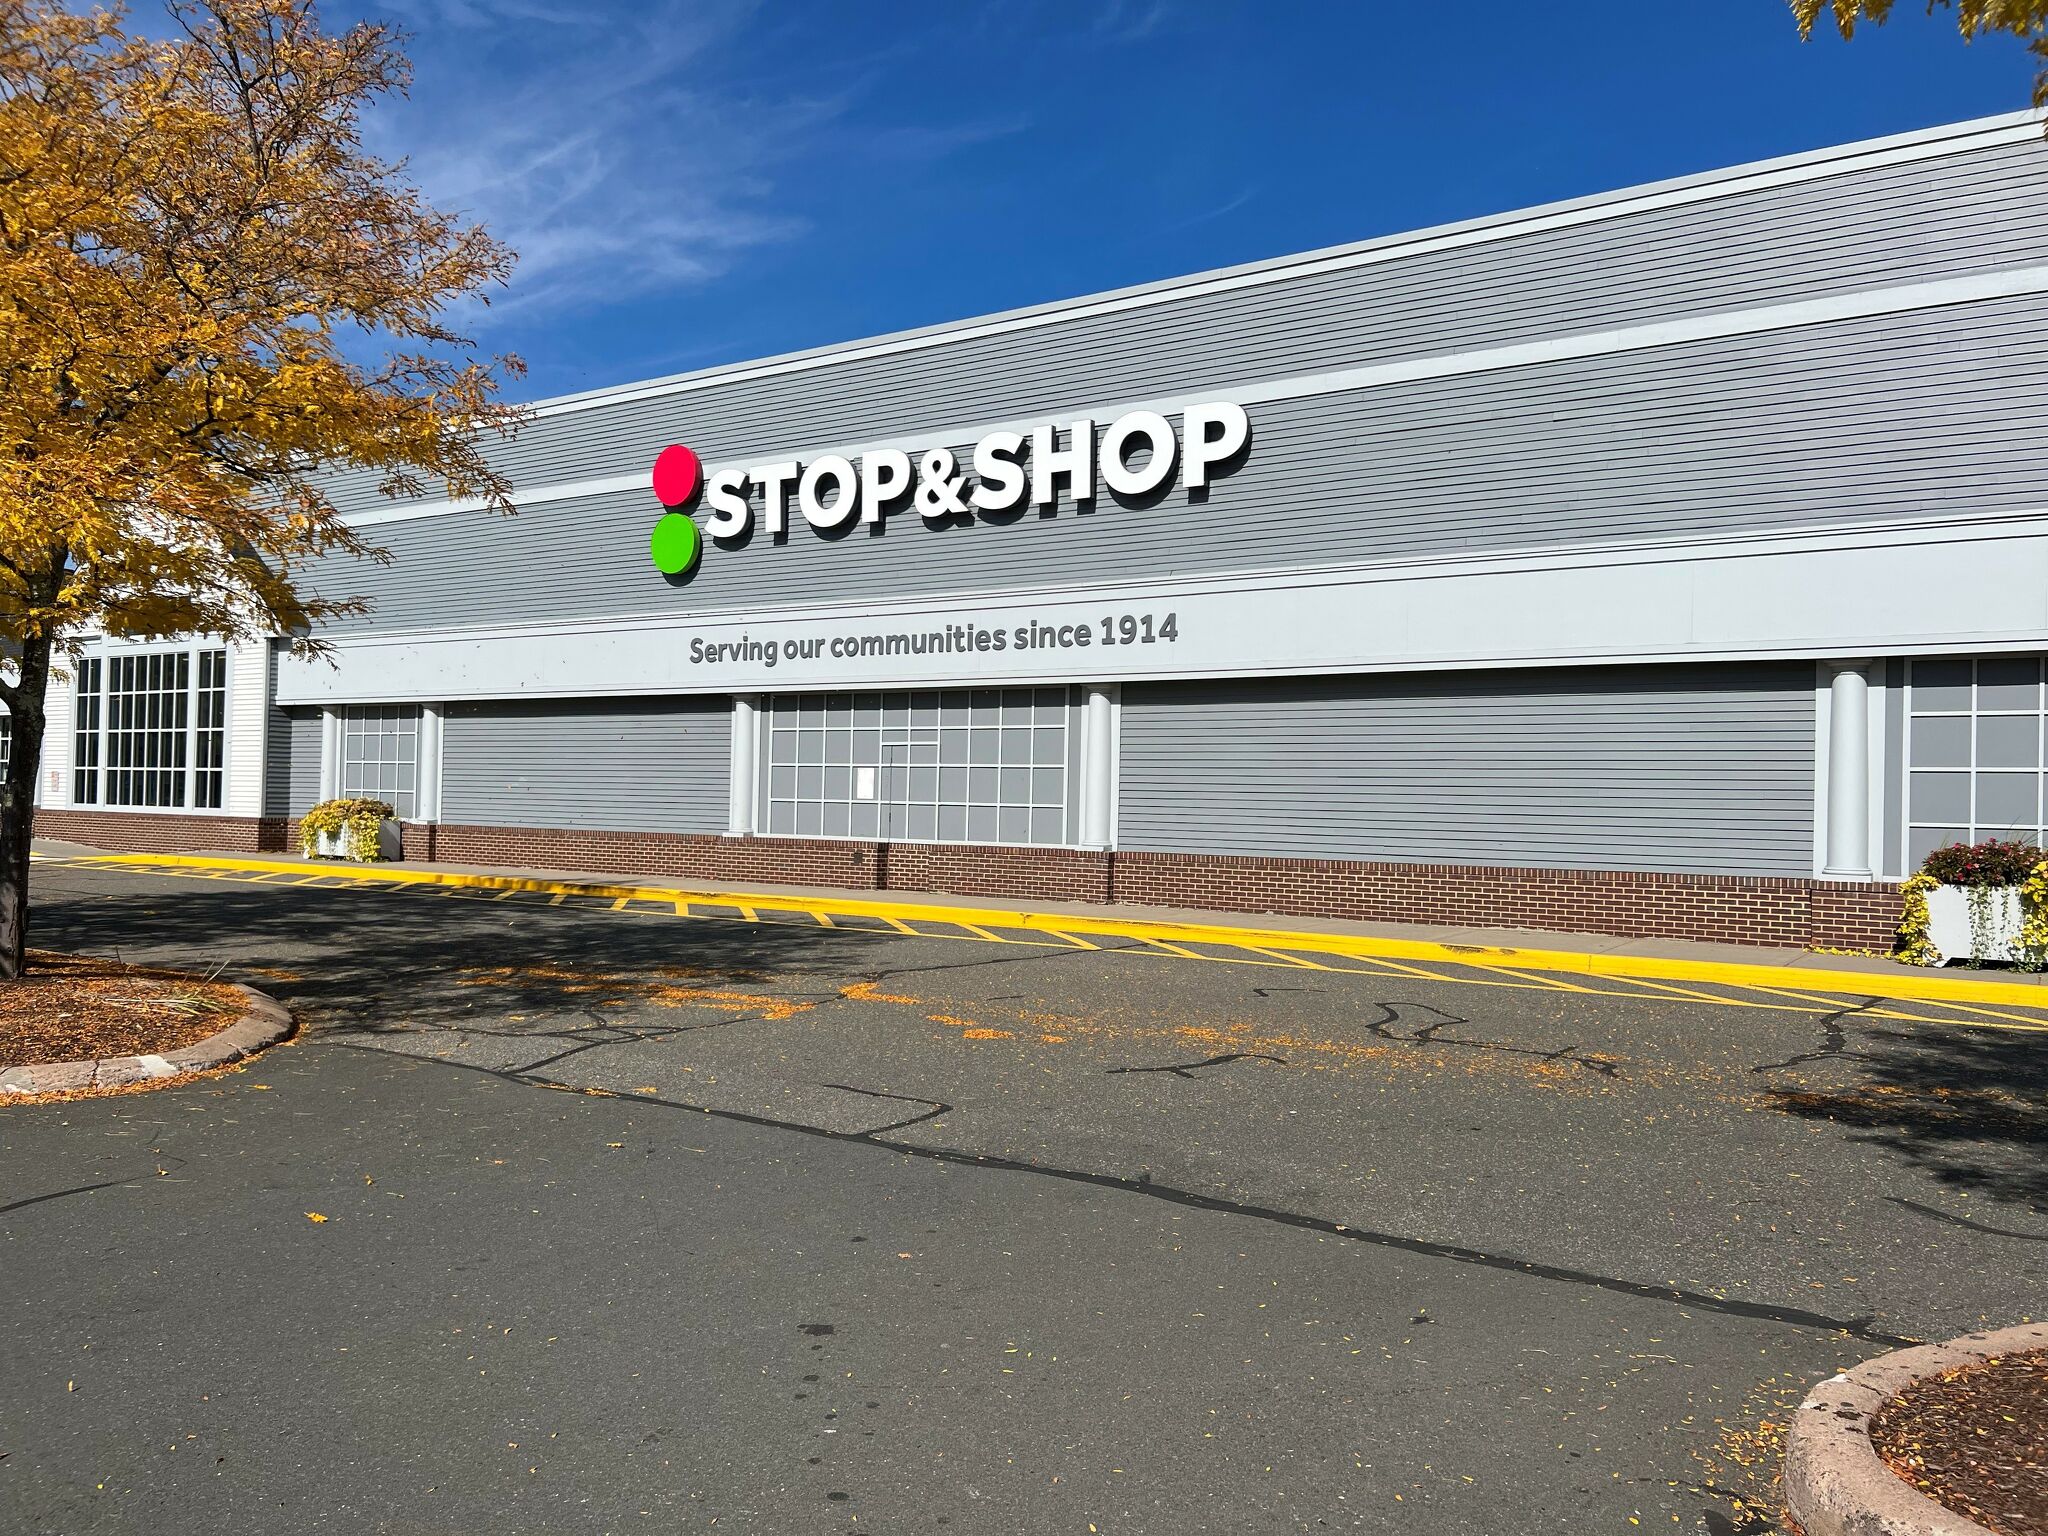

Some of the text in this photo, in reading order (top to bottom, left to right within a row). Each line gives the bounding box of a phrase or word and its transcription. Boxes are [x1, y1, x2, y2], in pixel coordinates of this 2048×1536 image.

[704, 401, 1250, 538] STOP&SHOP
[689, 613, 1179, 667] Serving our communities since 1914
